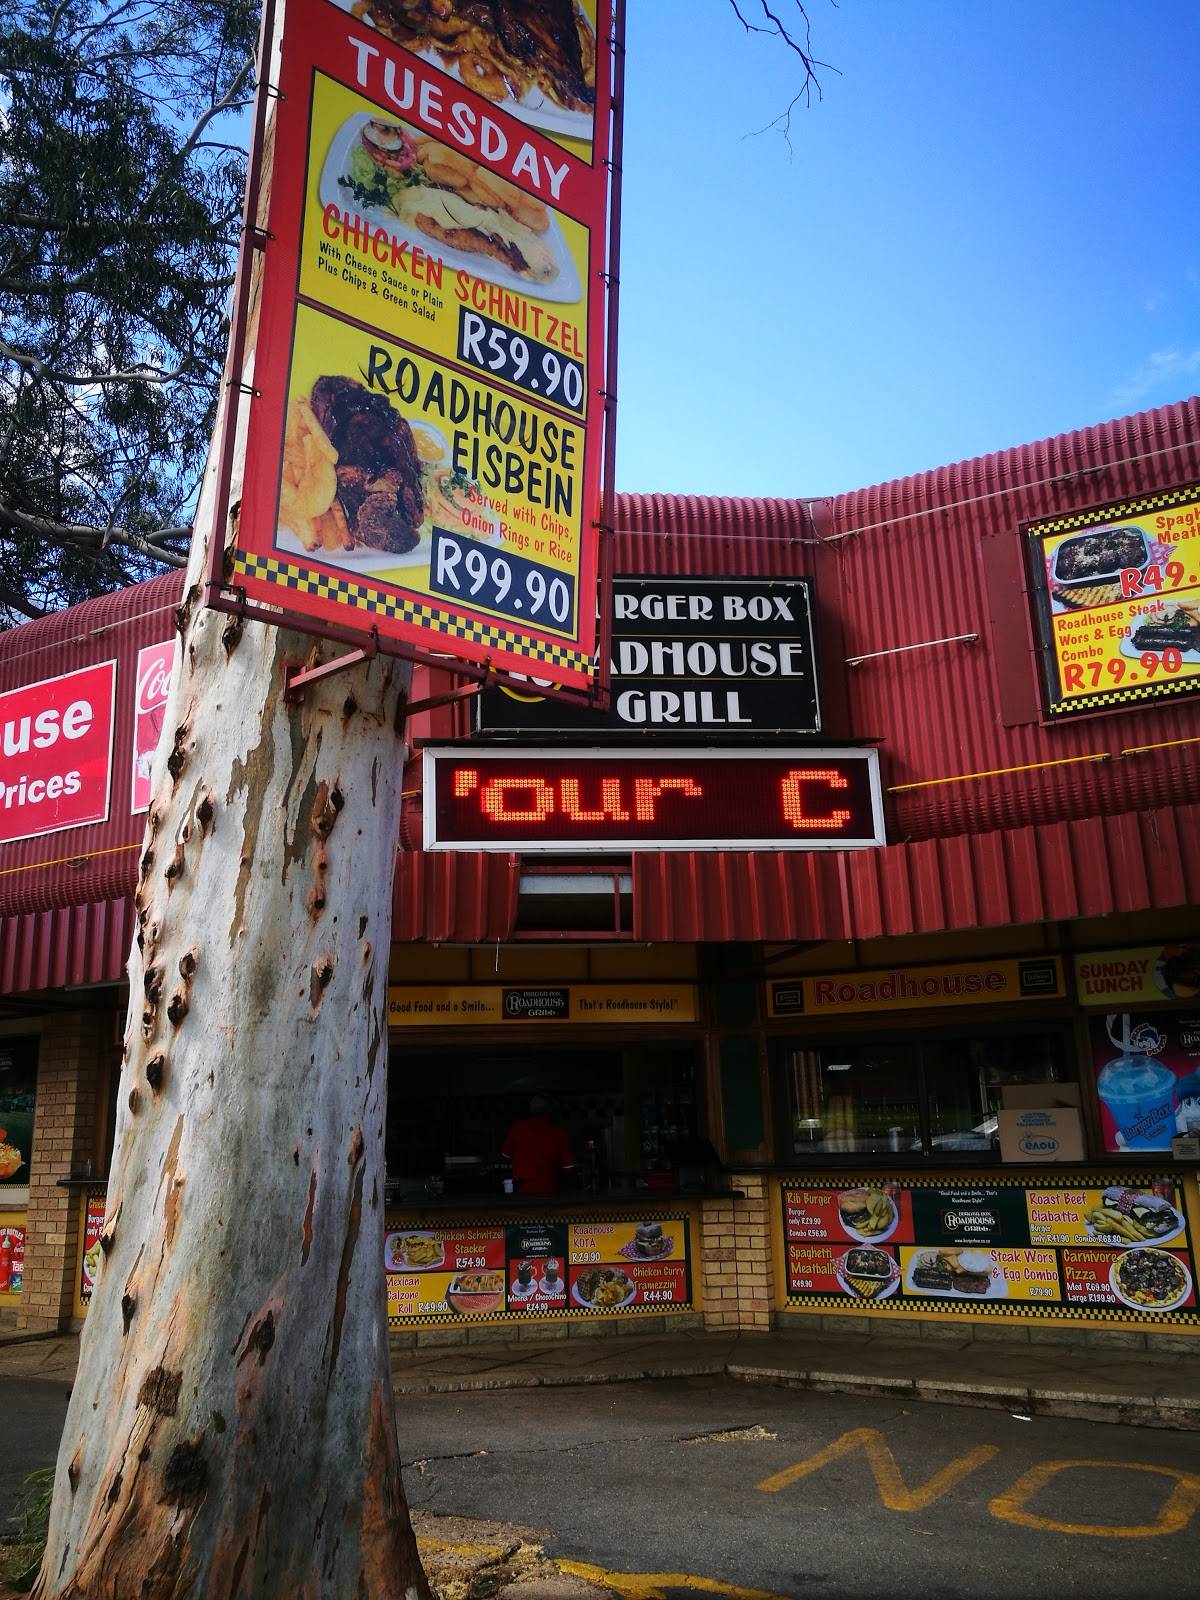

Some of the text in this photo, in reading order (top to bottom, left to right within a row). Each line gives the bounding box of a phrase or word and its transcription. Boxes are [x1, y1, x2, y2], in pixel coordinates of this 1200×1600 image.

[347, 36, 571, 200] TUESDAY
[319, 240, 444, 308] With Cheese Sauce or Plain
[322, 203, 583, 358] CHICKEN SCHNITZEL
[318, 256, 436, 322] Plus Chips & Green Salad
[462, 311, 583, 407] R59.90
[367, 344, 575, 471] ROADHOUSE
[452, 430, 573, 517] EISBEIN
[468, 483, 573, 543] Served with Chips,
[462, 508, 572, 562] Onion Rings or Rice
[436, 536, 570, 623] R99.90
[1120, 561, 1200, 598] R49.
[596, 594, 794, 621] RGER BOX
[1058, 600, 1165, 631] Roadhouse Steak
[1059, 624, 1132, 647] Wors & Egg
[1061, 646, 1103, 662] Combo
[1063, 646, 1182, 692] R79.90
[617, 690, 752, 723] GRILL
[0, 700, 93, 757] use
[782, 770, 850, 828] C
[1080, 960, 1149, 979] SUNDAY
[815, 970, 1006, 1006] Roadhouse
[1086, 976, 1143, 994] LUNCH
[414, 1001, 433, 1012] Food
[436, 1001, 451, 1012] and
[606, 999, 647, 1010] Roadhouse
[787, 1192, 832, 1207] Rib Burger
[1029, 1191, 1086, 1205] Roast Beef
[1031, 1210, 1079, 1222] Ciabatta
[434, 1228, 503, 1241] Chicken Schnitzel
[573, 1225, 614, 1235] Roadhouse
[455, 1243, 486, 1254] Stacker
[573, 1238, 596, 1248] KOTA
[790, 1246, 832, 1260] Spaghetti
[991, 1250, 1054, 1263] Steak Wors
[1063, 1249, 1117, 1263] Carnivore
[456, 1257, 486, 1268] R54.90
[791, 1261, 836, 1275] Meatballs
[633, 1265, 685, 1278] Chicken Curry
[992, 1267, 1058, 1281] & Egg Combo
[1066, 1266, 1097, 1280] Pizza
[386, 1277, 420, 1287] Mexican
[634, 1279, 677, 1290] Tramezzini
[387, 1290, 419, 1301] Calzone
[643, 1290, 673, 1302] R44.90
[1067, 1292, 1087, 1303] Large
[398, 1301, 448, 1314] Roll R49.90
[755, 1427, 1200, 1537] NO
